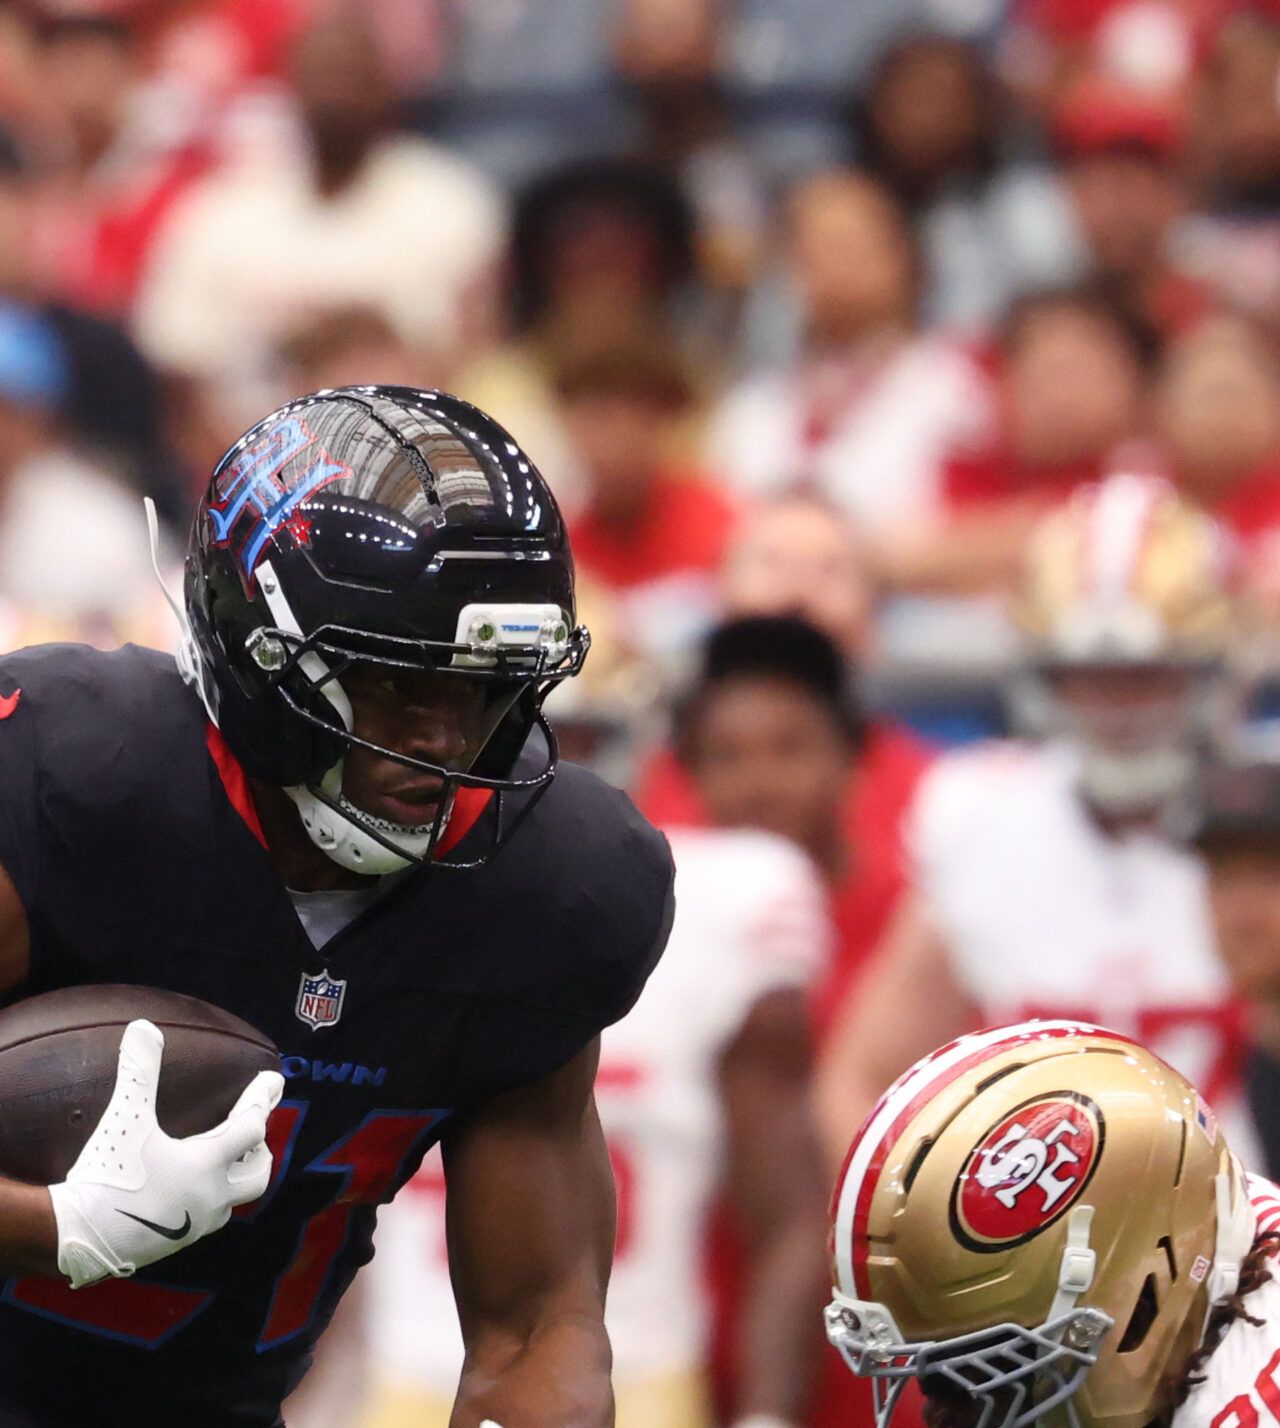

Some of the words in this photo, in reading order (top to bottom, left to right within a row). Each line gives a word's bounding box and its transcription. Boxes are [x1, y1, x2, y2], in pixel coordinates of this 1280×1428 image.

[303, 995, 334, 1020] NFL
[278, 1052, 389, 1087] OWN
[976, 1118, 1080, 1213] SF
